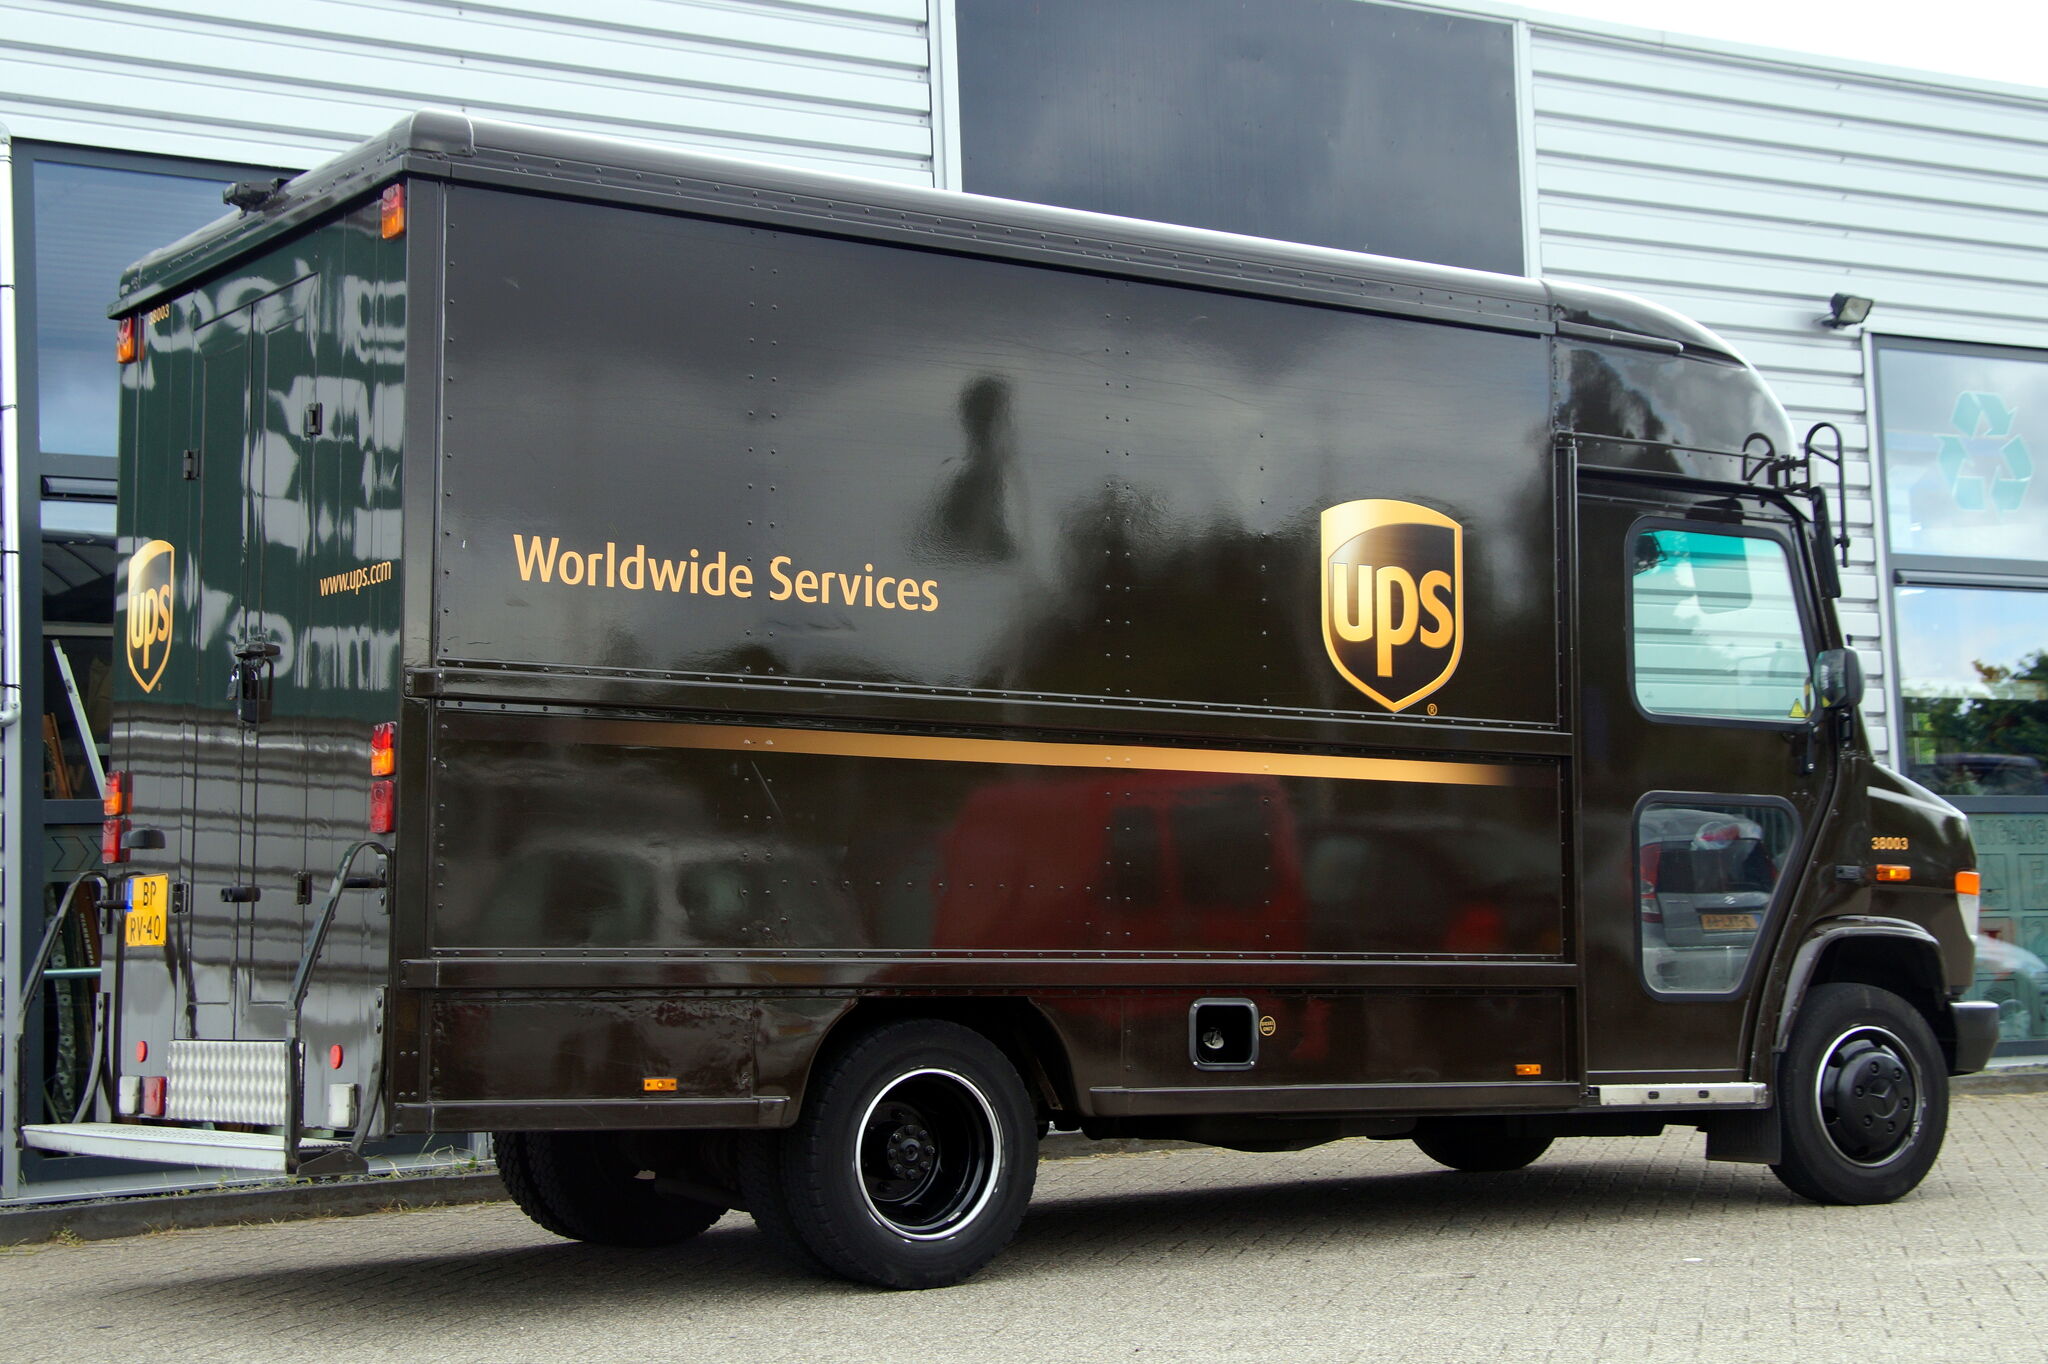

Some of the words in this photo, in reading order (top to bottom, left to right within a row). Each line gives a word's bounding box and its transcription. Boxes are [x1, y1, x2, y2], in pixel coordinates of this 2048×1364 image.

[513, 534, 754, 598] Worldwide
[769, 556, 939, 612] Services
[1871, 836, 1909, 850] 38003
[143, 881, 157, 906] BP
[130, 915, 161, 941] RV-40
